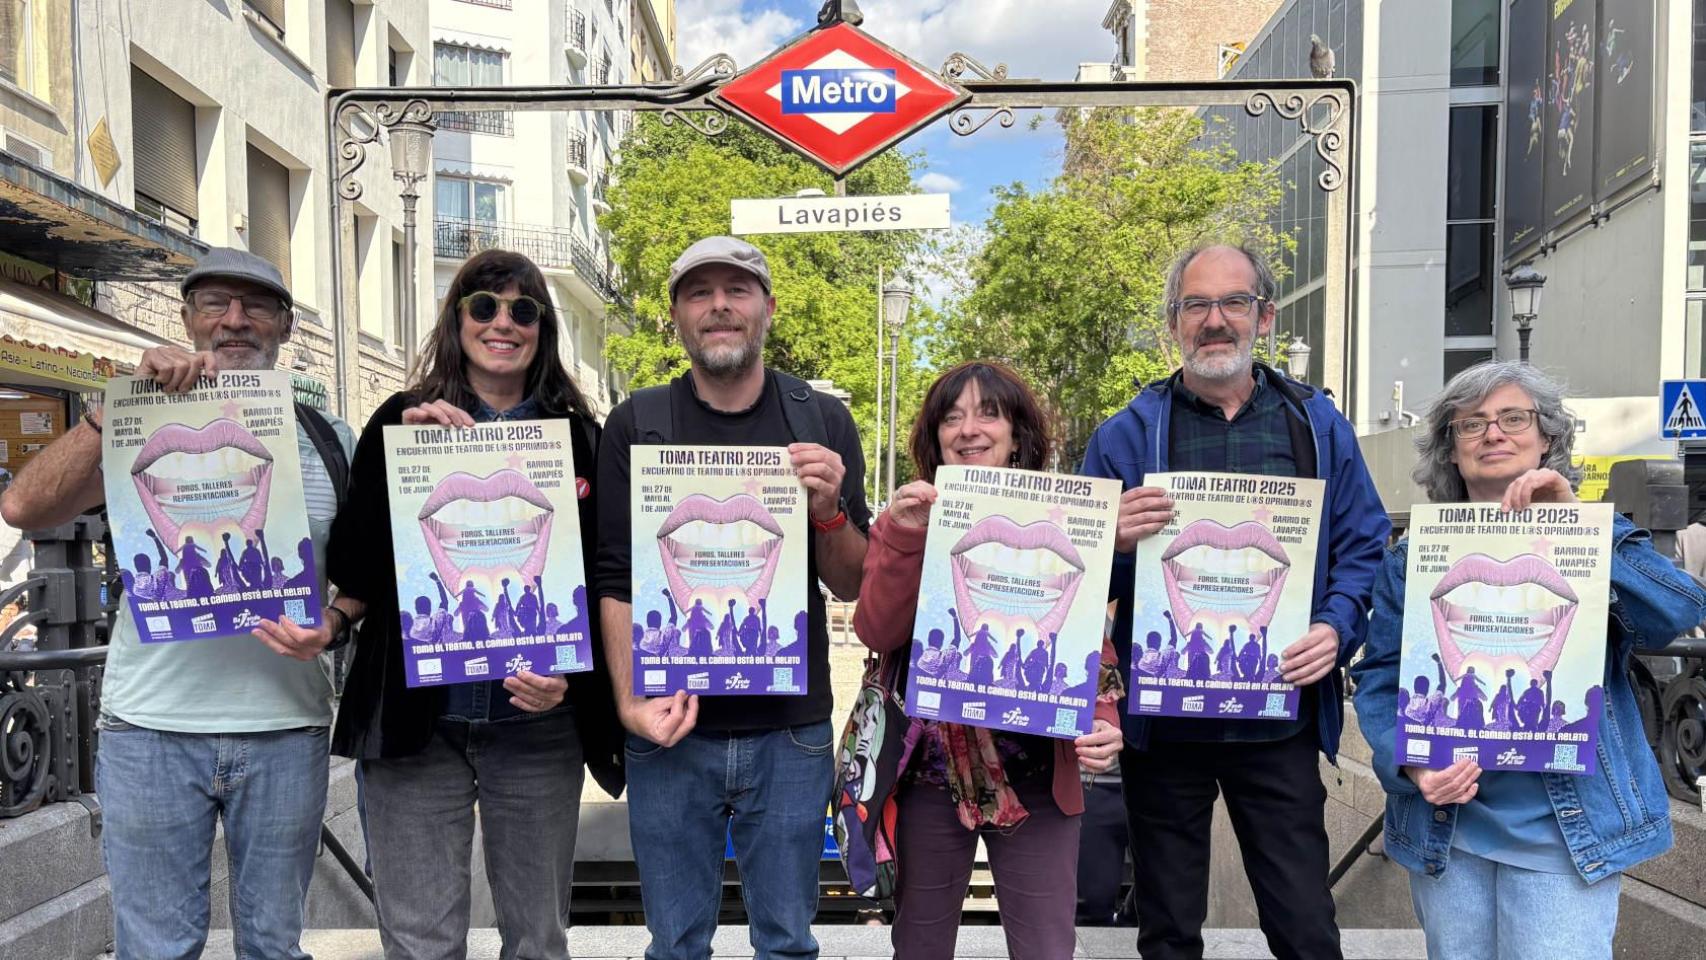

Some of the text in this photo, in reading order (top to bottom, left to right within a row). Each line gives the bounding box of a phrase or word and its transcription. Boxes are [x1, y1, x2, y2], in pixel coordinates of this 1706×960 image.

[792, 76, 888, 104] Metro
[778, 202, 902, 228] Lavapiés
[1, 350, 21, 365] Asia
[30, 357, 58, 373] Latino
[131, 380, 164, 394] TOMA
[222, 374, 260, 388] 2025
[113, 396, 154, 408] ENCUENTRO
[156, 395, 166, 404] DE
[168, 393, 197, 403] TEATRO
[199, 392, 209, 401] DE
[243, 407, 271, 417] BARRIO
[112, 418, 123, 427] DEL
[134, 417, 143, 425] DE
[115, 427, 132, 436] MAYO
[412, 425, 542, 443] TOMA TEATRO 2025
[115, 439, 125, 447] DE
[126, 438, 145, 447] JUNIO
[396, 446, 442, 456] ENCUENTRO
[455, 444, 482, 453] TEATRO
[484, 444, 494, 452] DE
[658, 449, 780, 465] TOMA TEATRO 2025
[526, 460, 553, 468] BARRIO
[641, 466, 684, 475] ENCUENTRO
[963, 468, 1092, 496] TOMA TEATRO 2025
[1170, 476, 1296, 496] TOMA TEATRO 2025
[173, 489, 238, 503] REPRESENTACIONES
[944, 482, 988, 495] ENCUENTRO
[990, 487, 999, 496] DE
[1001, 489, 1028, 500] TEATRO
[1030, 492, 1039, 501] DE
[1207, 494, 1233, 502] TEATRO
[942, 499, 953, 508] DEL
[942, 509, 961, 518] MAYO
[1437, 508, 1475, 522] TOMA
[1536, 509, 1578, 523] 2025
[1067, 516, 1106, 528] BARRIO DE
[1272, 515, 1299, 523] BARRIO
[952, 521, 971, 530] JUNIO
[1419, 525, 1463, 534] ENCUENTRO
[1465, 526, 1475, 534] DE
[1477, 526, 1506, 534] TEATRO
[1509, 526, 1520, 534] DE
[456, 535, 520, 548] REPRESENTACIONES
[1070, 538, 1097, 547] MADRID
[1554, 546, 1586, 555] BARRIO
[690, 558, 750, 567] REPRESENTACIONES
[981, 582, 1045, 597] REPRESENTACIONES
[1192, 584, 1254, 593] REPRESENTACIONES
[1464, 624, 1534, 634] REPRESENTACIONES
